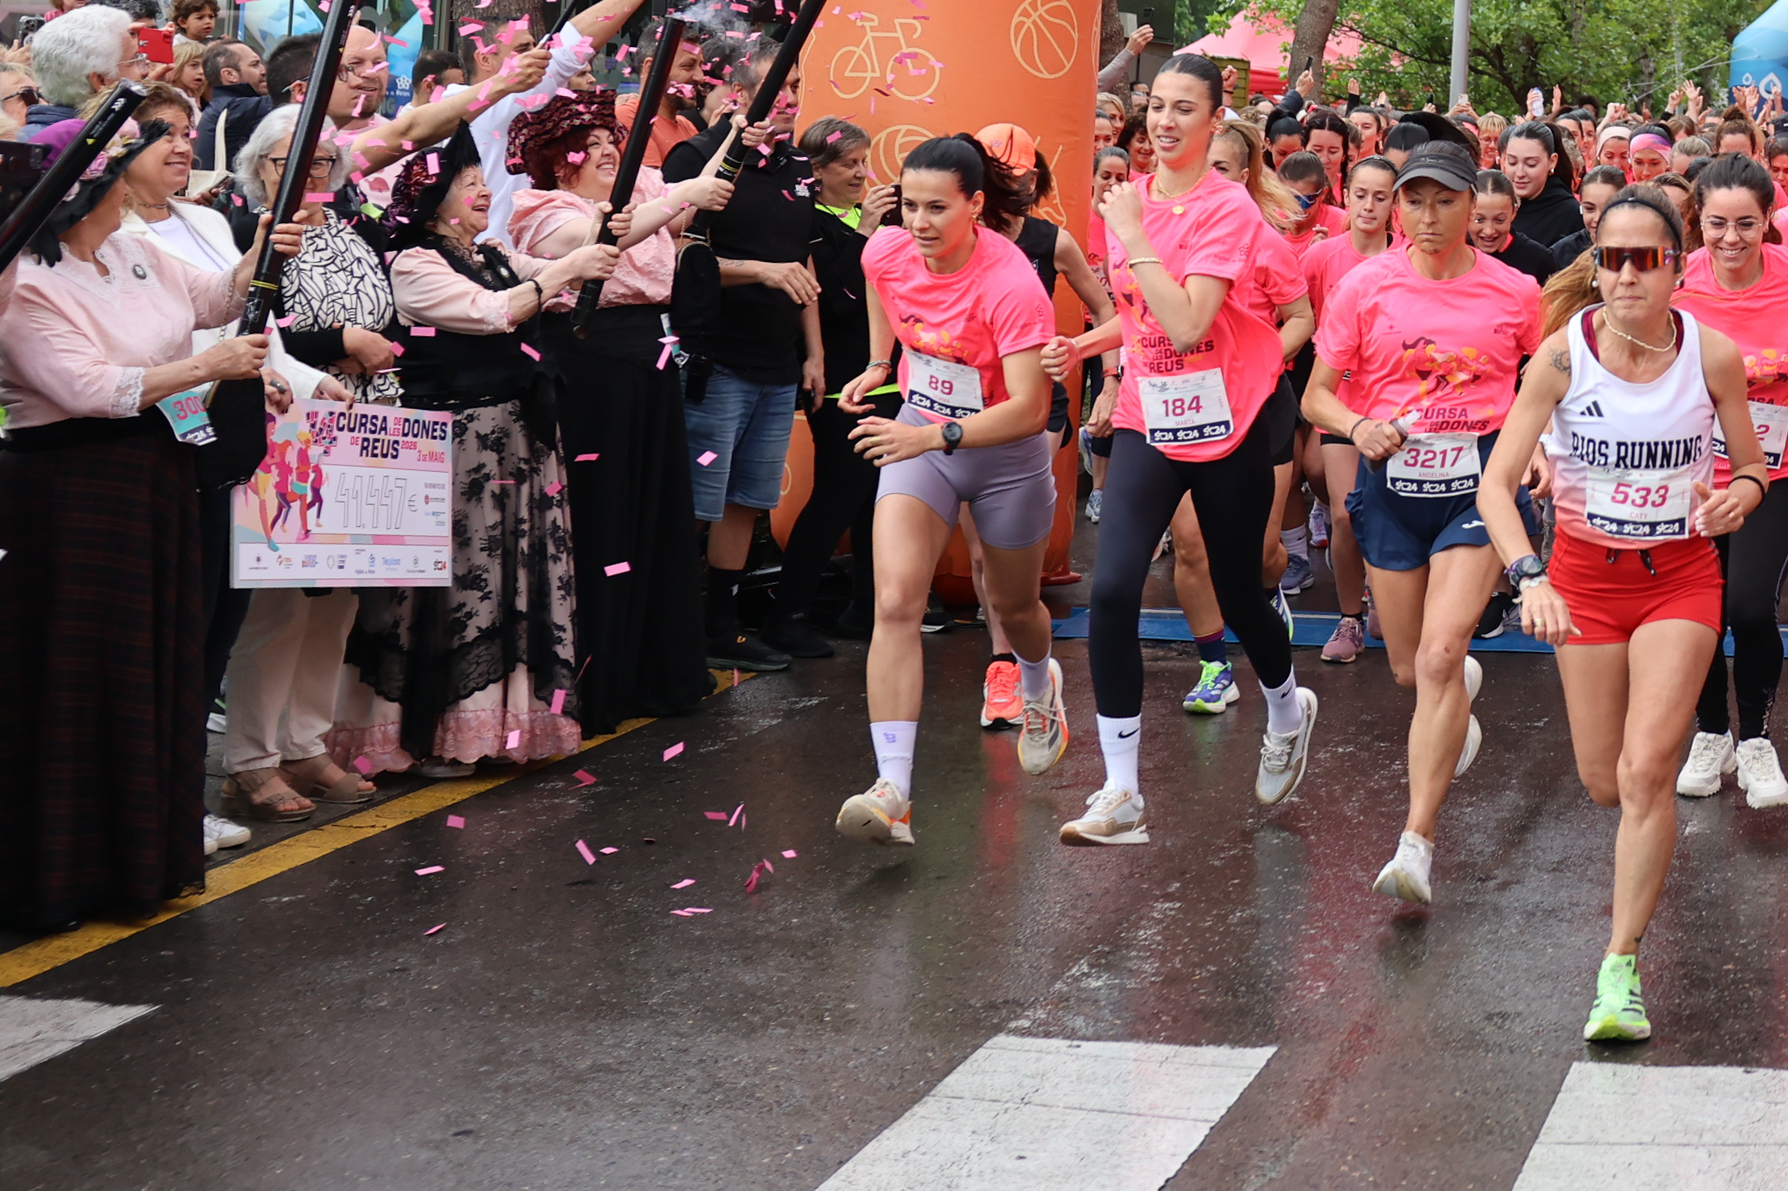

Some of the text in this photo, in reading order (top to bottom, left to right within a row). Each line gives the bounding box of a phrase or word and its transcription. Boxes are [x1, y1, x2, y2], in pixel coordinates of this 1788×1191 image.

[1141, 336, 1173, 348] CURS
[1149, 359, 1184, 373] REUS
[929, 375, 954, 395] 89
[1162, 395, 1203, 417] 184
[336, 411, 388, 436] CURSA
[394, 417, 402, 426] DE
[402, 418, 448, 441] DONES
[389, 428, 401, 437] LES
[1440, 420, 1490, 431] DONES
[350, 436, 417, 460] DE REUS 2026
[428, 451, 445, 464] MAIG
[1404, 446, 1464, 469] 3217
[1615, 434, 1702, 469] RUNNING
[1610, 482, 1669, 508] 533
[1629, 512, 1648, 520] CATY
